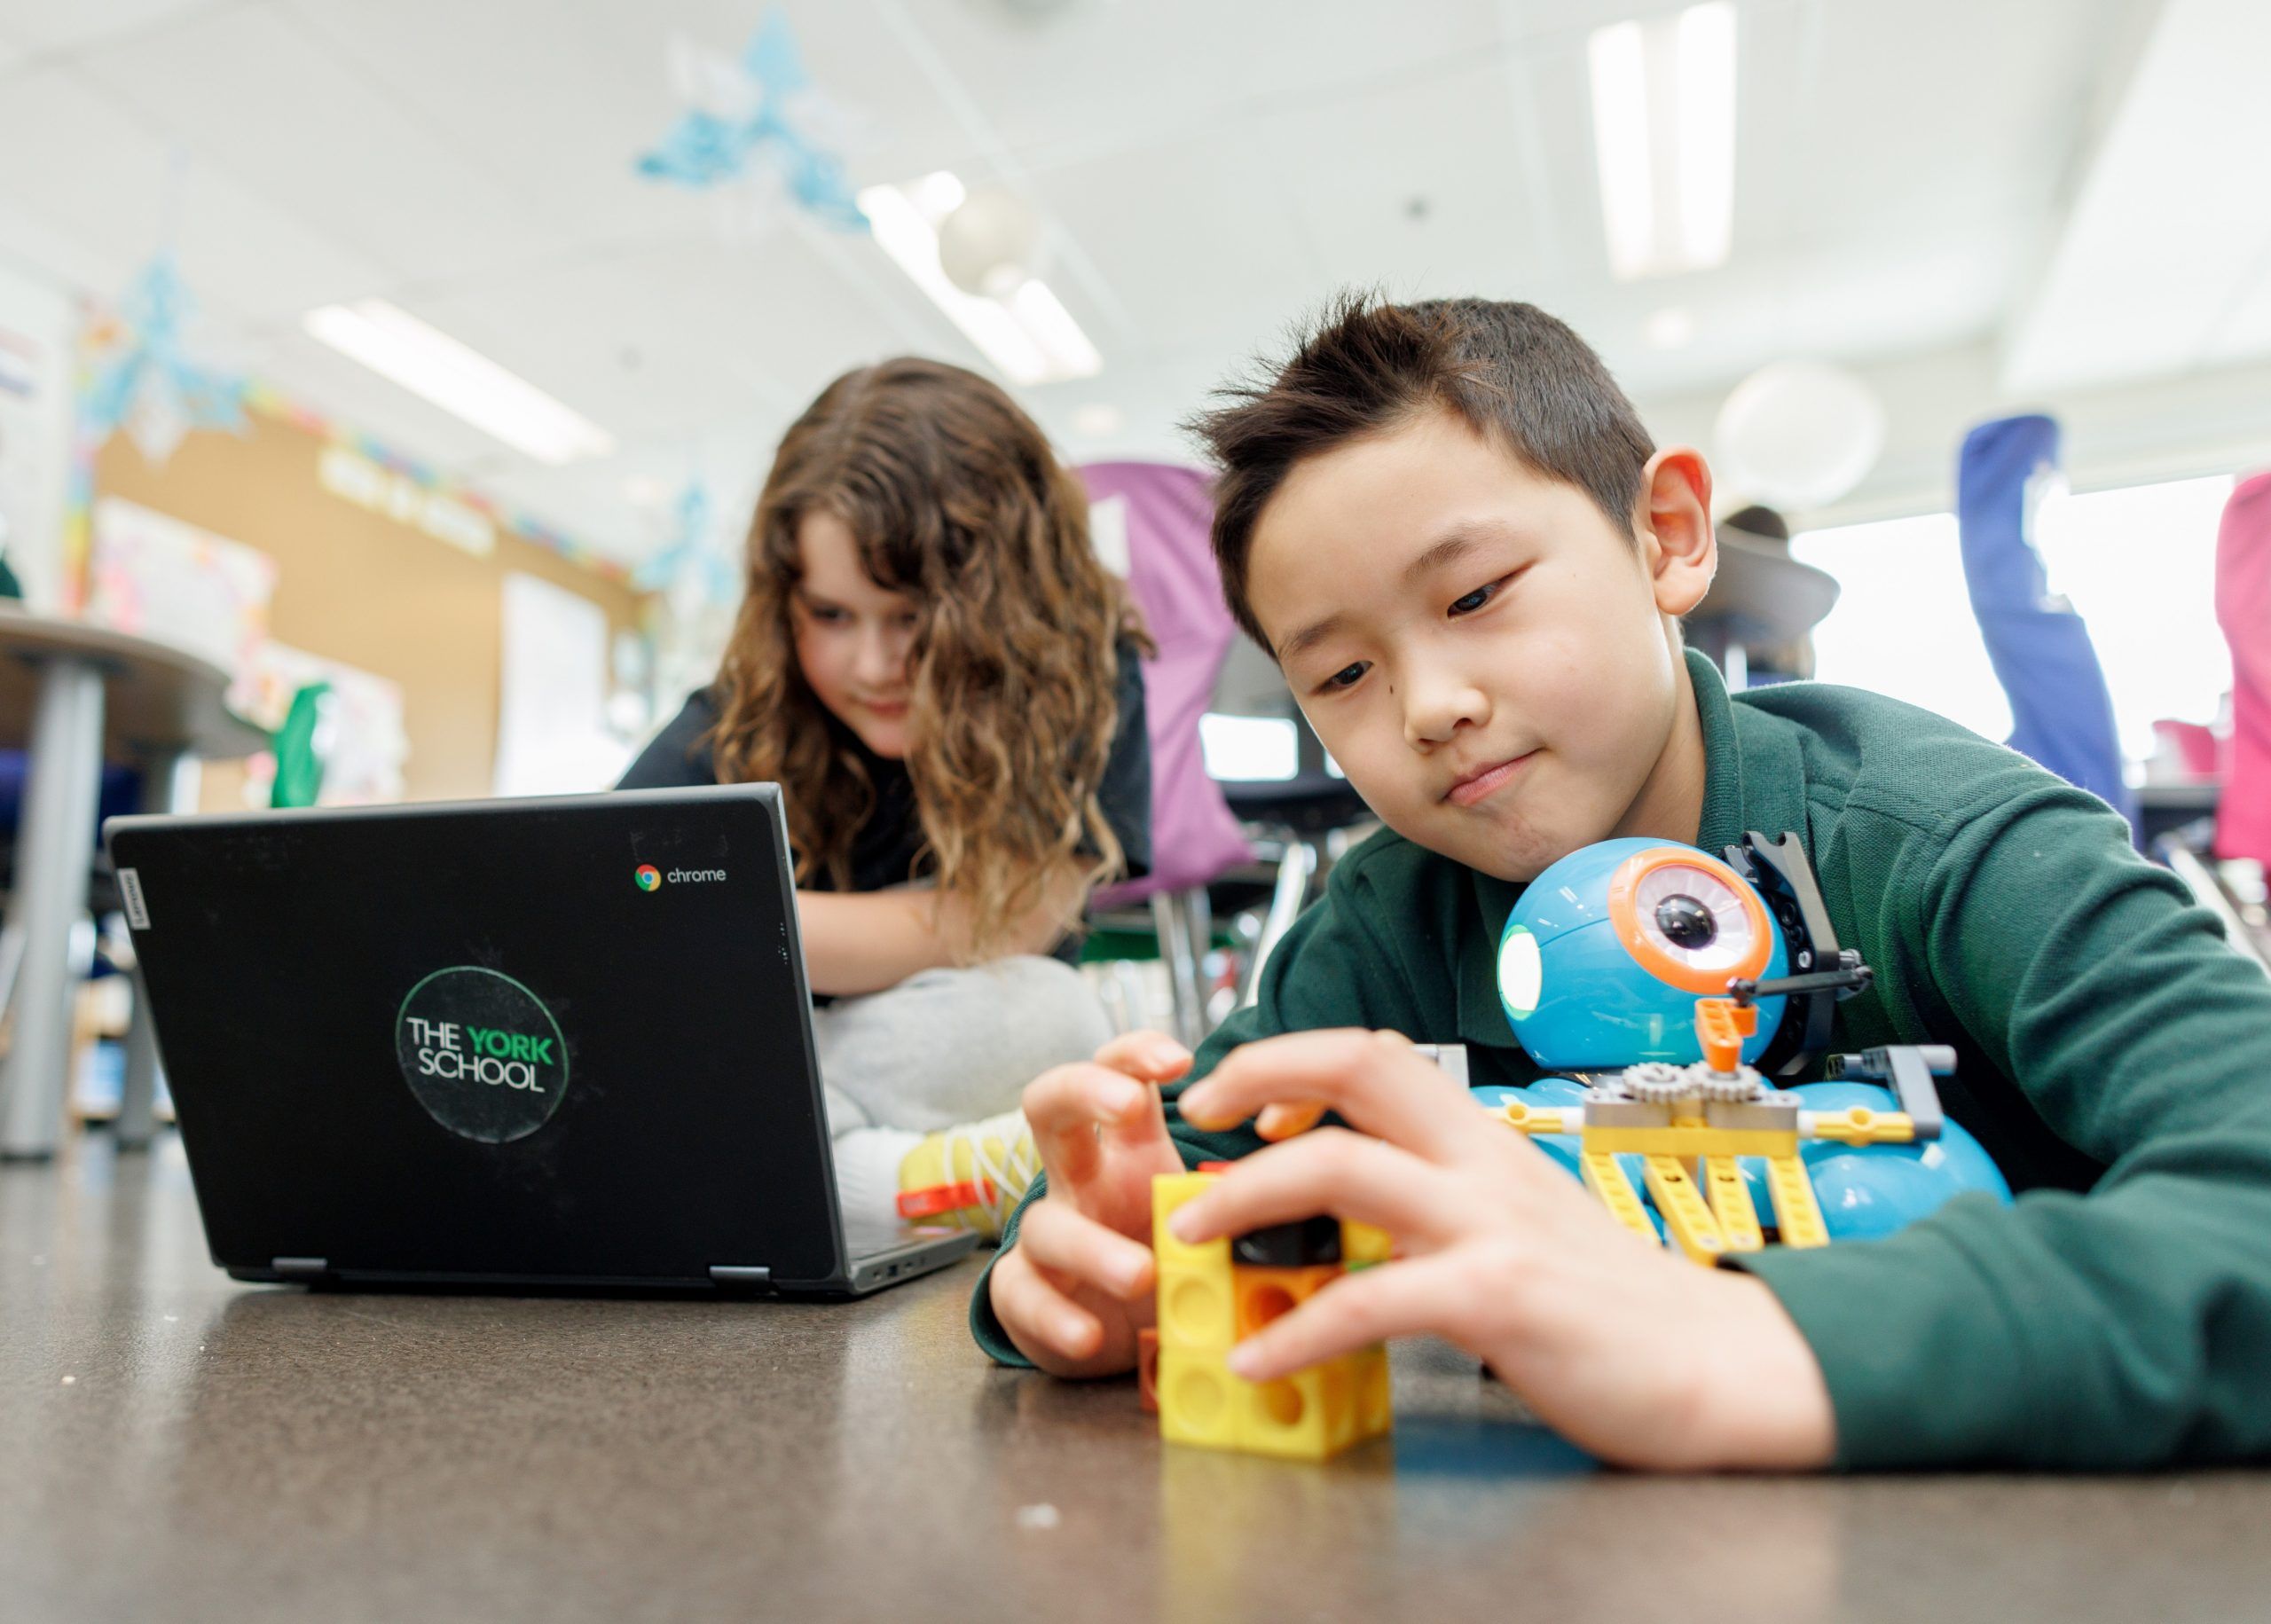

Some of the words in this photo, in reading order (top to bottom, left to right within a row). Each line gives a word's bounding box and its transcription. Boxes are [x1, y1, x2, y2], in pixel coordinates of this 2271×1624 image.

[667, 867, 726, 883] chrome
[406, 1017, 461, 1051] THE
[466, 1026, 554, 1065] YORK
[418, 1047, 546, 1093] SCHOOL
